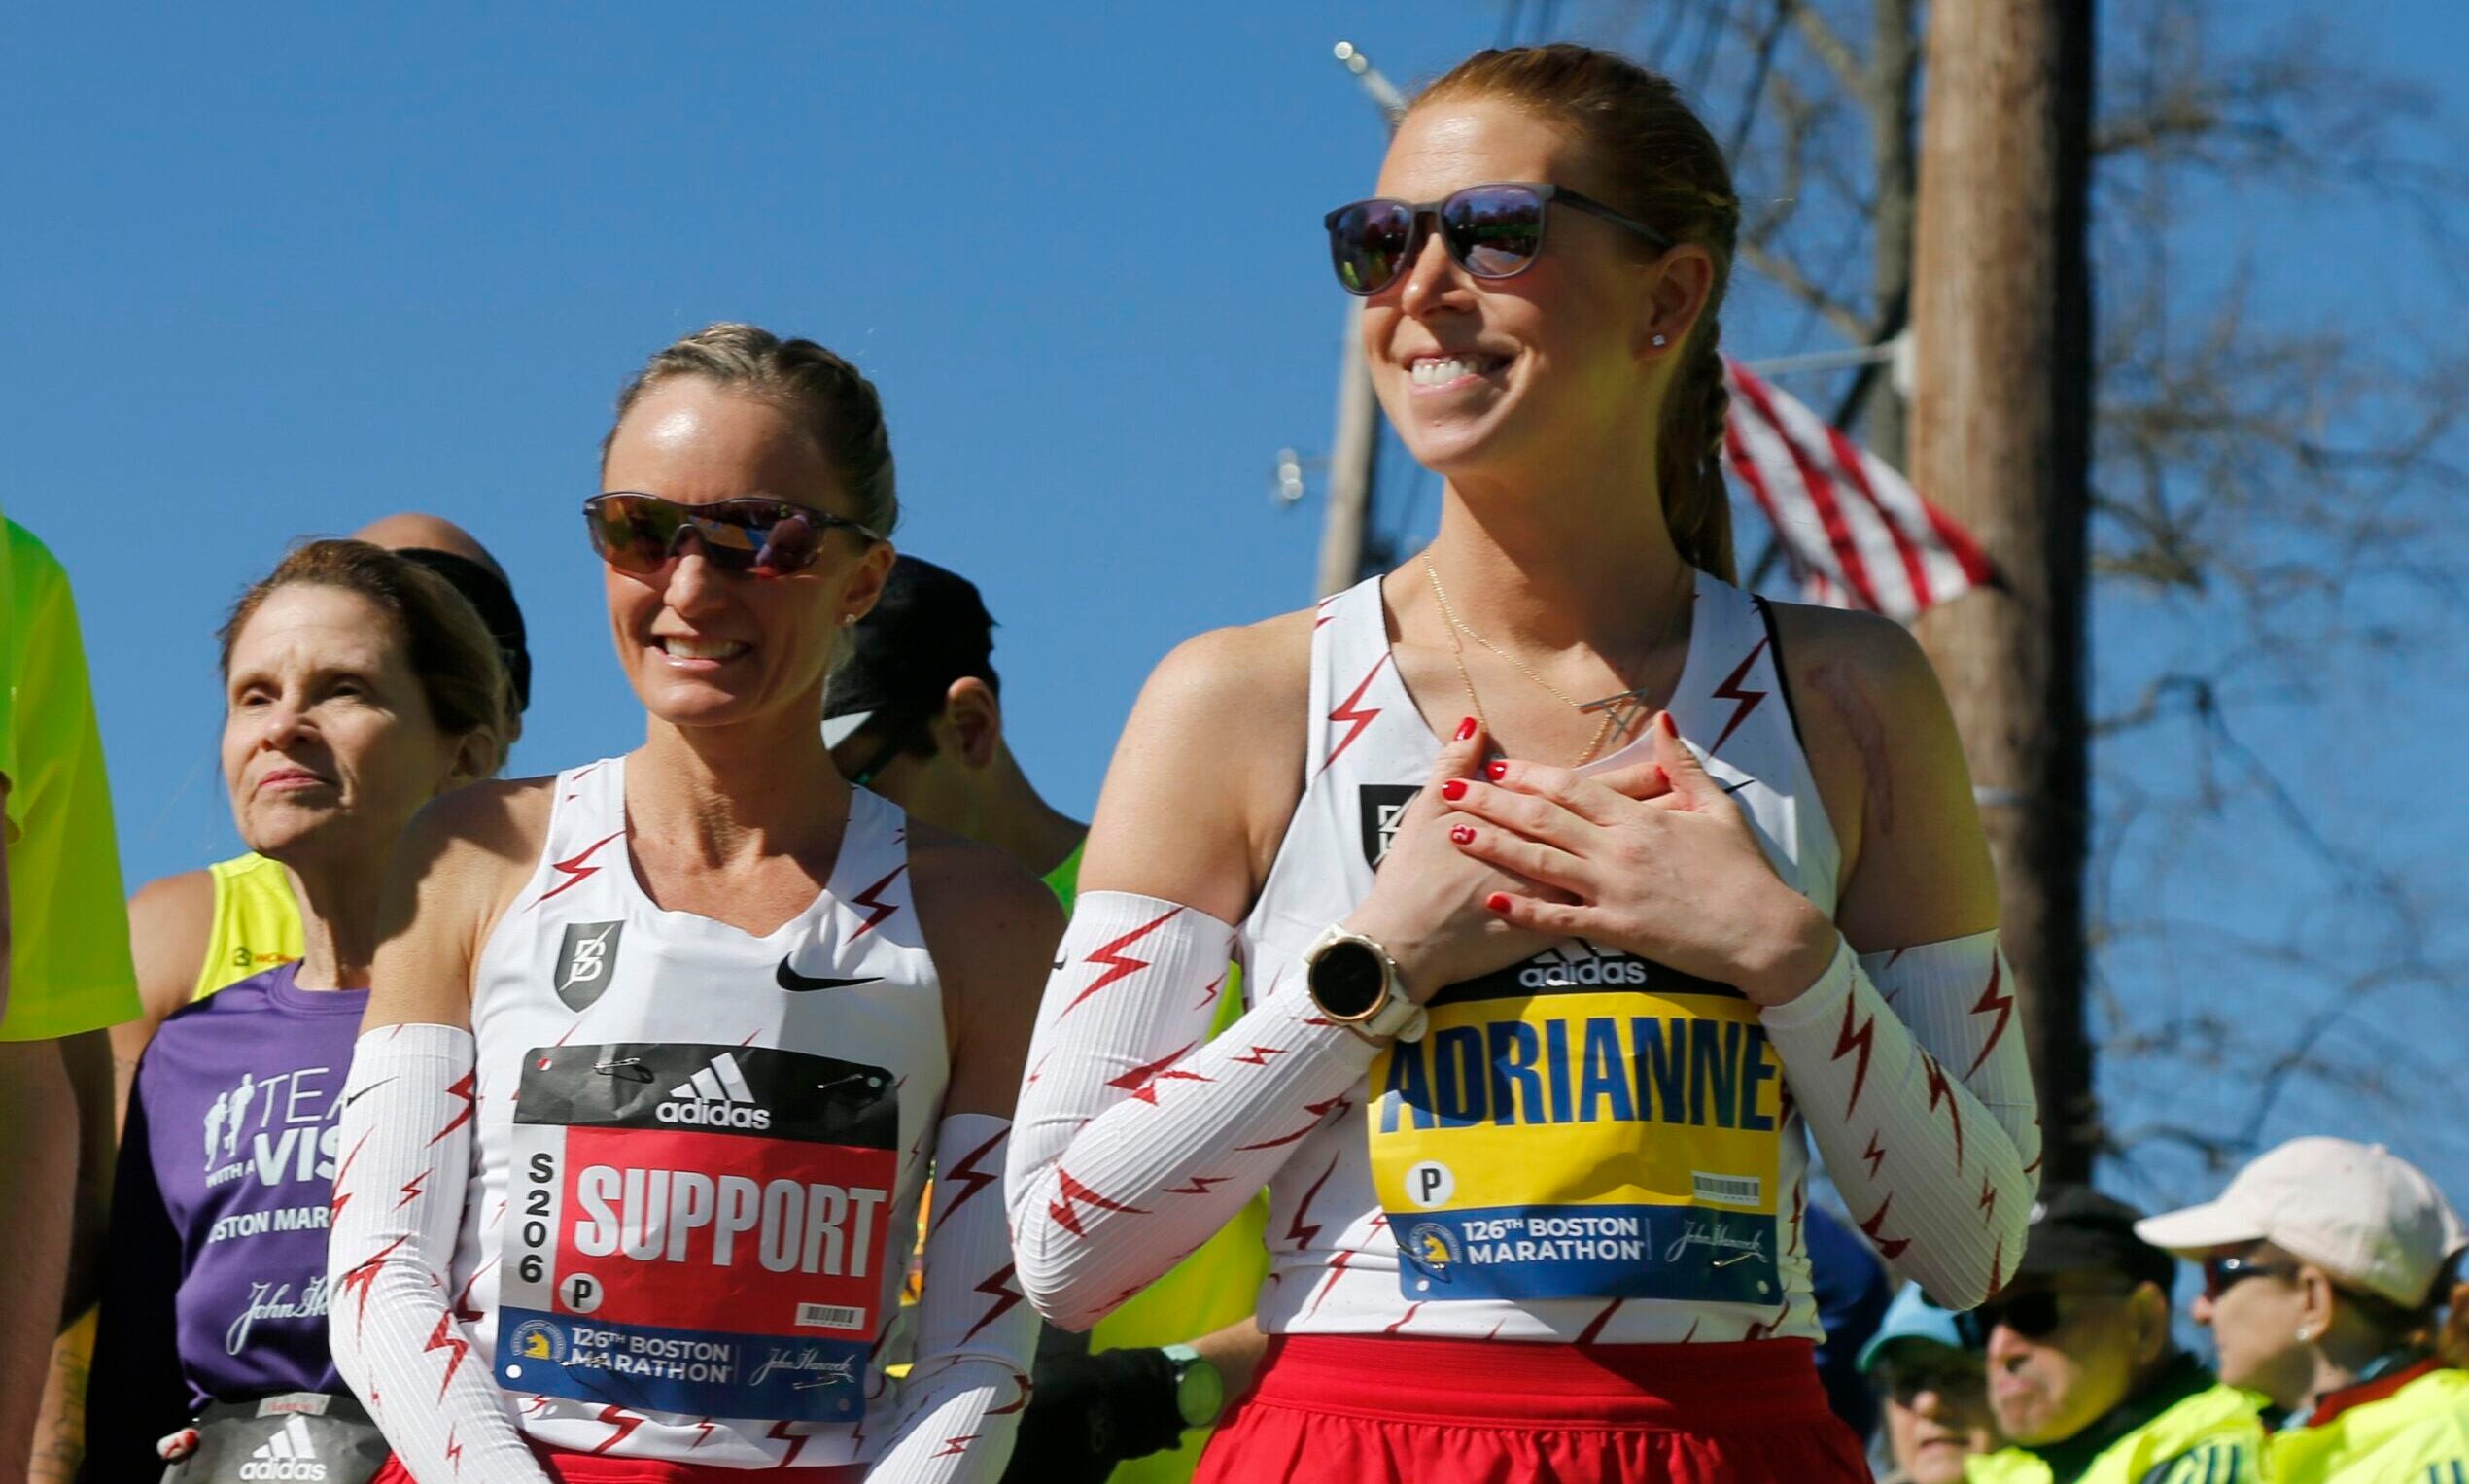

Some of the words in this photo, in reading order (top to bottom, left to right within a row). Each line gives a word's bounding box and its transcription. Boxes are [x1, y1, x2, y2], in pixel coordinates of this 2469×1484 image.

[1519, 956, 1647, 987] adidas
[1380, 1016, 1776, 1134] ADRIANNE
[655, 1098, 771, 1130] adidas
[205, 1162, 243, 1189] WITH
[1421, 1167, 1442, 1203] P
[208, 1210, 269, 1244] STON
[574, 1165, 887, 1278] SUPPORT
[1462, 1218, 1525, 1242] 126TH
[1529, 1217, 1639, 1238] BOSTON
[1468, 1239, 1641, 1265] MARATHON
[572, 1279, 593, 1308] P
[572, 1327, 626, 1349] 126TH
[630, 1335, 729, 1362] BOSTON
[571, 1348, 729, 1384] MARATHON
[239, 1458, 328, 1481] adidas
